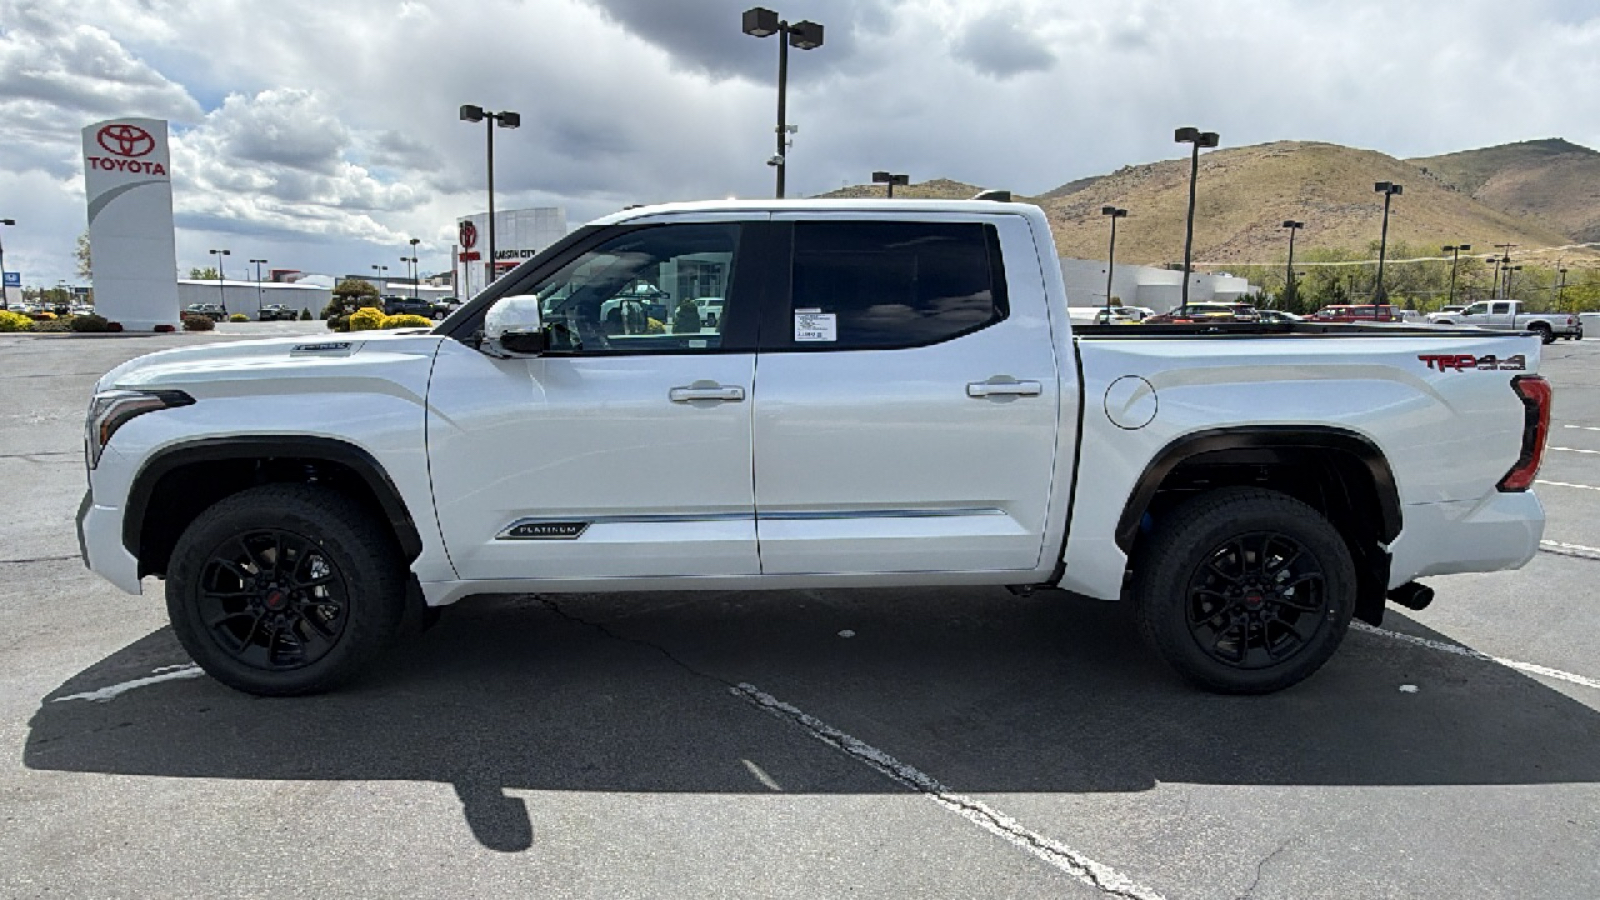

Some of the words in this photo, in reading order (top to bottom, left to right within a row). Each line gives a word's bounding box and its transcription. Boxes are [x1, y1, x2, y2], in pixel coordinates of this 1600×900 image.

[87, 157, 166, 176] TOYOTA
[1417, 354, 1477, 373] TRD
[520, 526, 576, 534] PLATINUM
